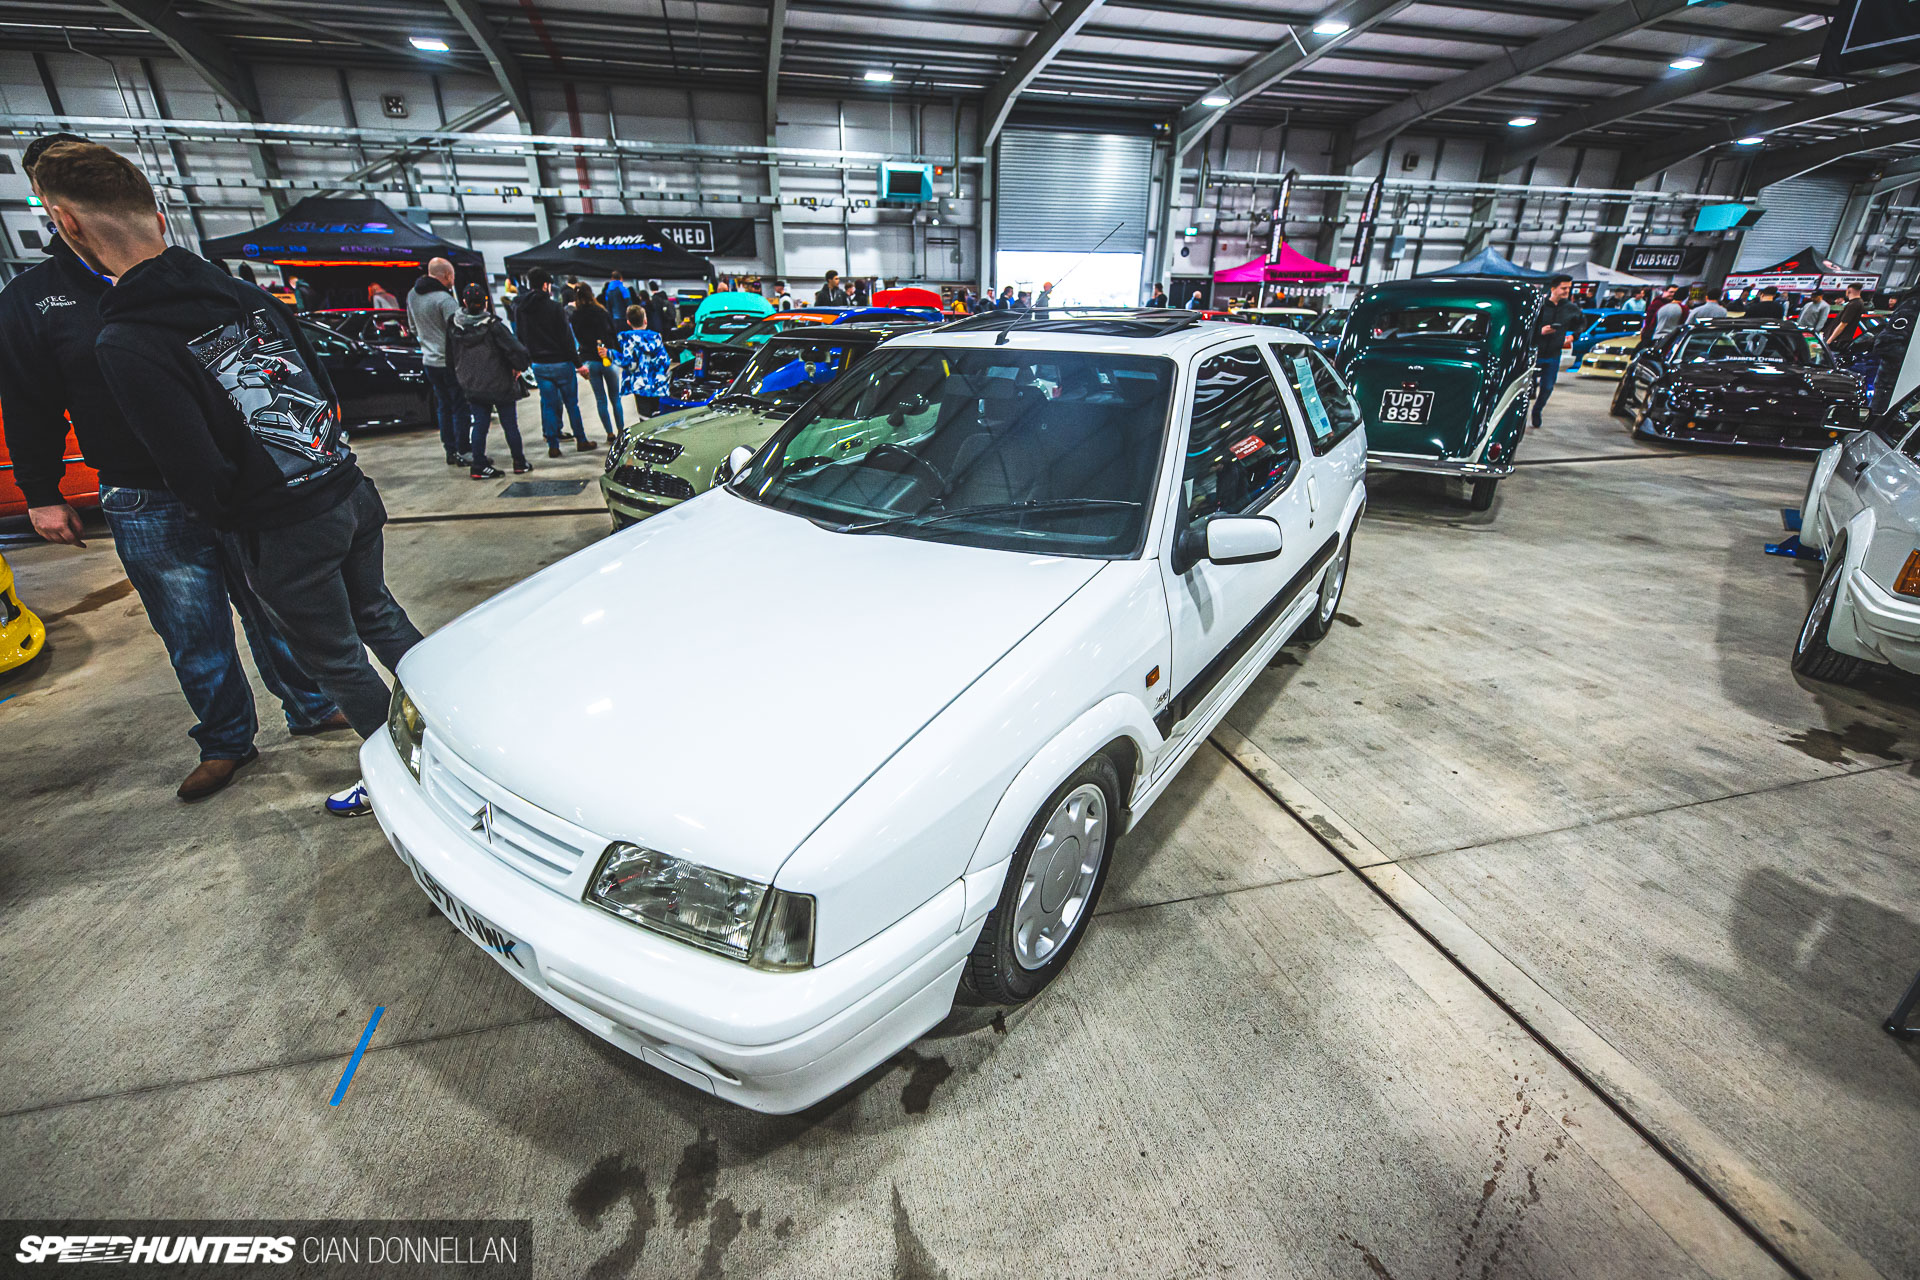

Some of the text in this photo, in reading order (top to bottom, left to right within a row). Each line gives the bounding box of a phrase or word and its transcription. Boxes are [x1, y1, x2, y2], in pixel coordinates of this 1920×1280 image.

[558, 234, 646, 250] ALPHA VINYL
[1635, 254, 1681, 266] DUBSHED
[1390, 393, 1425, 408] UPD
[1387, 407, 1421, 422] 835
[460, 906, 525, 969] NWK
